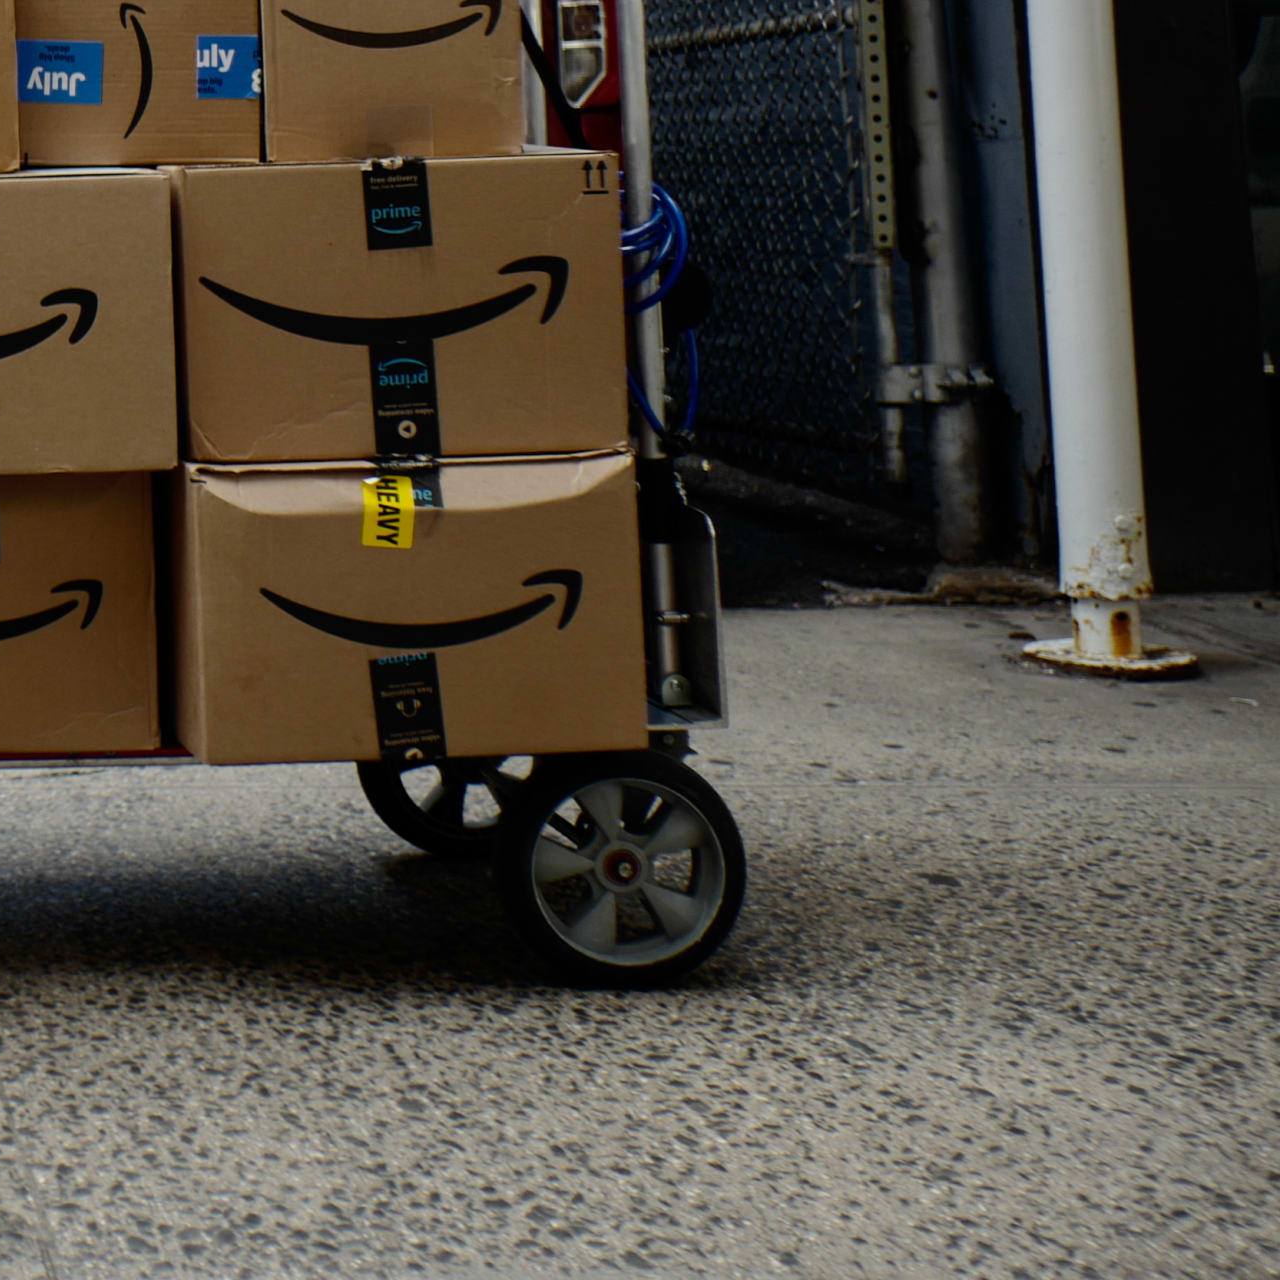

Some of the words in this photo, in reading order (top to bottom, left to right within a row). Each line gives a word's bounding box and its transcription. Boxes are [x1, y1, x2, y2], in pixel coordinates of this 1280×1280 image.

[26, 66, 86, 97] July
[371, 202, 422, 224] prime
[378, 368, 430, 390] prime
[376, 478, 401, 546] HEAVY
